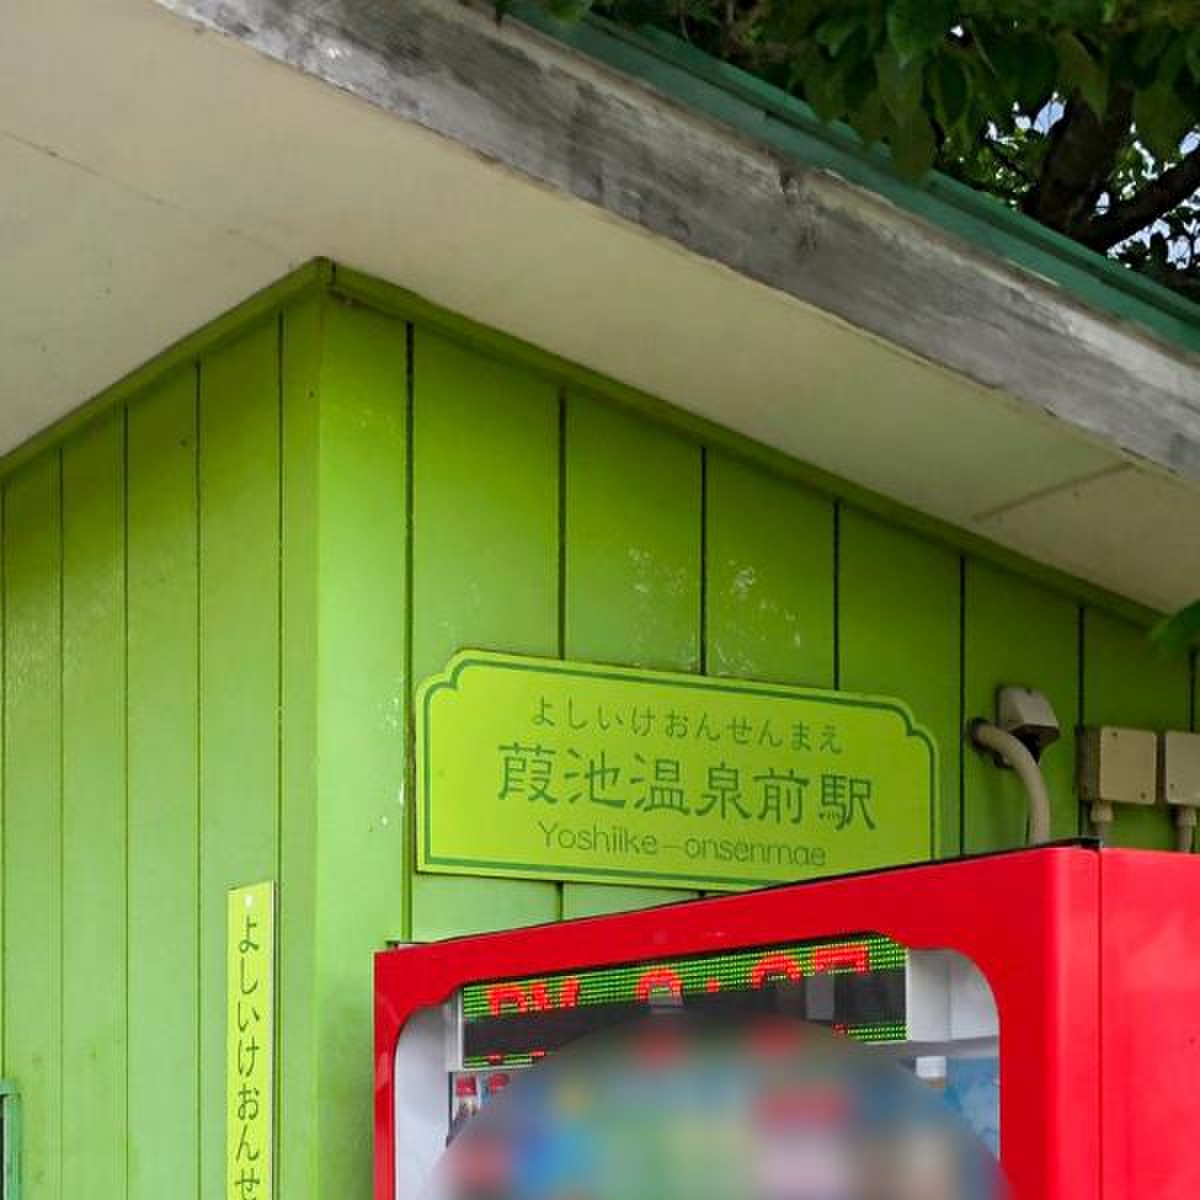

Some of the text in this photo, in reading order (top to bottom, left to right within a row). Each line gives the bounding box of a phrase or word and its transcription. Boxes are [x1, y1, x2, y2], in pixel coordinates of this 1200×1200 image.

[531, 694, 843, 755] よしいけおんせんまえ
[497, 741, 876, 832] 葭池温泉前駅
